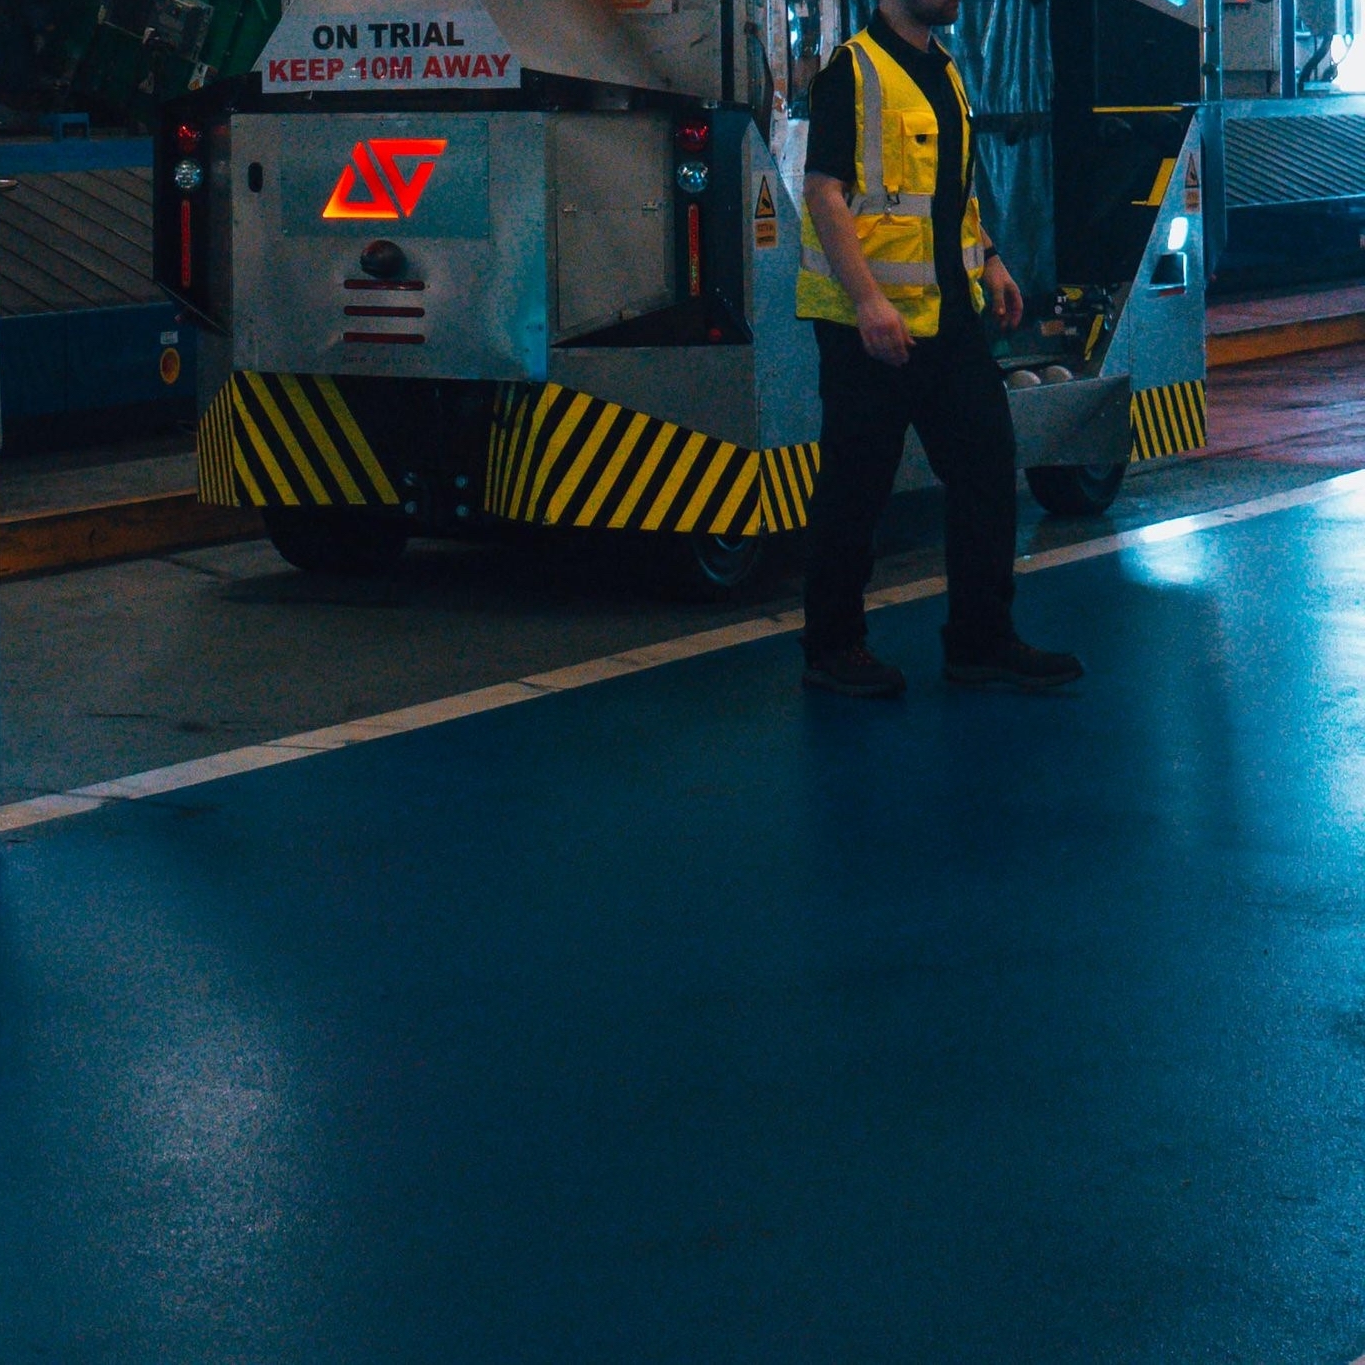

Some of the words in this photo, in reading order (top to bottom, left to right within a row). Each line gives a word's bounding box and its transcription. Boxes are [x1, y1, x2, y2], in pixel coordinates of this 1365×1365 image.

[312, 24, 358, 50] ON
[368, 22, 465, 49] TRIAL
[268, 57, 345, 83] KEEP
[354, 55, 413, 81] 10M
[421, 53, 512, 79] AWAY
